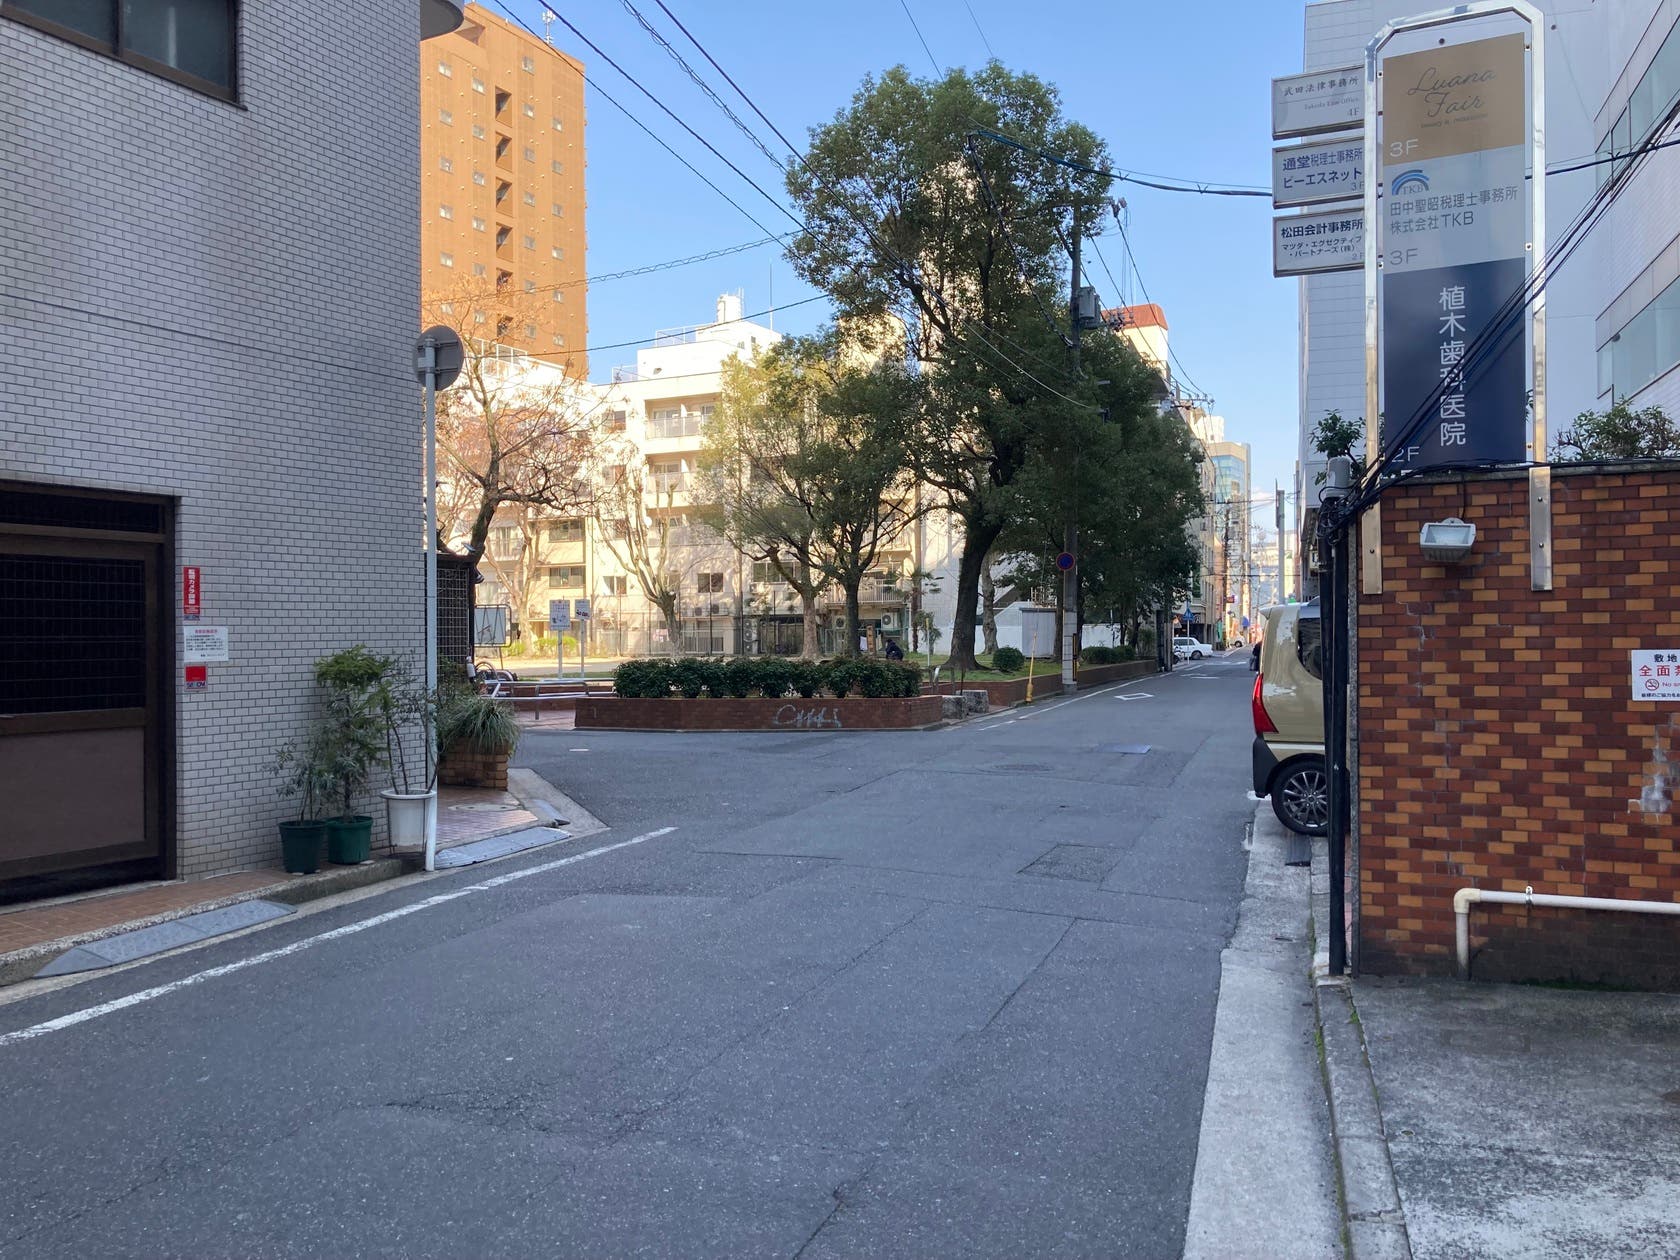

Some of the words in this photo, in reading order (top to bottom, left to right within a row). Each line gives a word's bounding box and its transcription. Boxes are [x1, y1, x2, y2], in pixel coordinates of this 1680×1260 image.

[1284, 76, 1359, 96] 武田法律事務所
[1407, 66, 1496, 95] Luana
[1424, 91, 1484, 118] Fair
[1390, 138, 1419, 157] 3F
[1283, 147, 1362, 171] 通堂税理士事務所
[1284, 168, 1362, 189] ビーエスネット
[1402, 184, 1424, 195] TKB
[1390, 185, 1518, 217] 田中聖昭税理士事務所
[1281, 219, 1363, 238] 松田会計事務所
[1390, 248, 1419, 266] 3F
[1438, 285, 1466, 447] 植木歯科医院
[1391, 446, 1420, 463] 2F
[1654, 653, 1678, 663] 敷地
